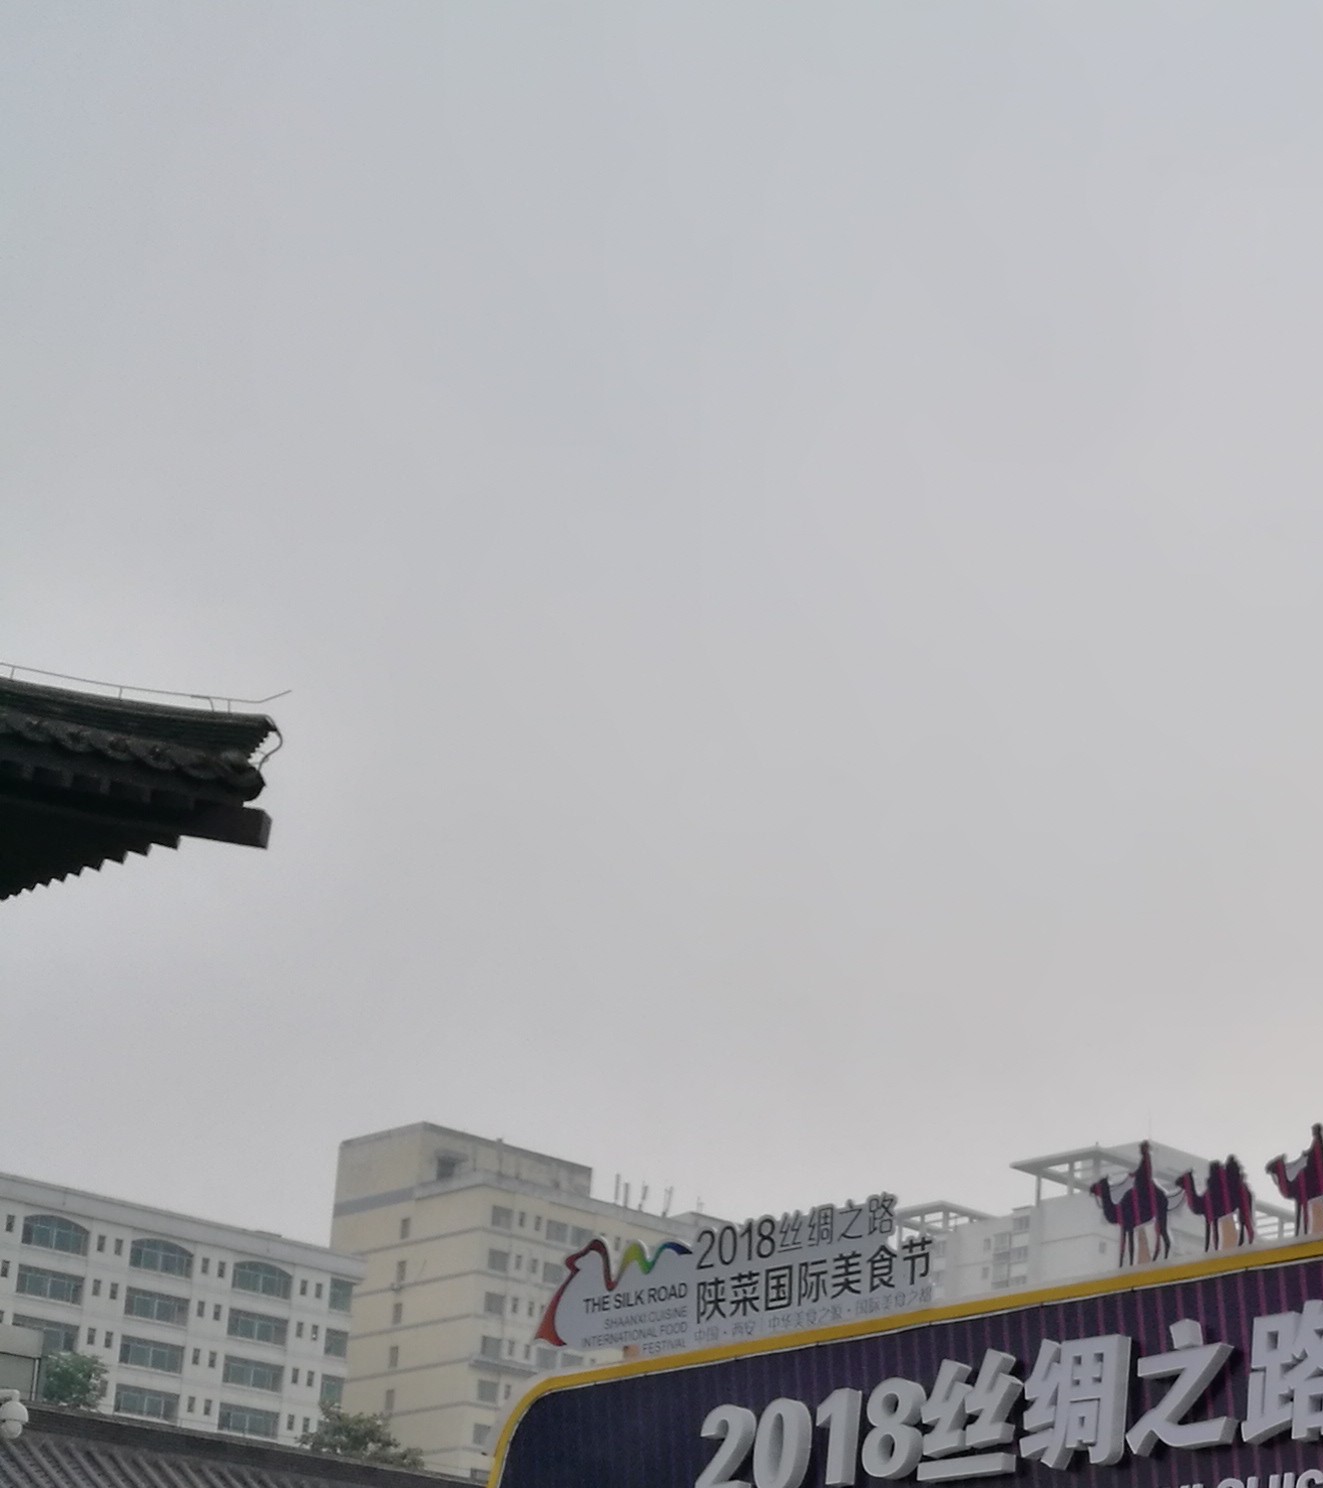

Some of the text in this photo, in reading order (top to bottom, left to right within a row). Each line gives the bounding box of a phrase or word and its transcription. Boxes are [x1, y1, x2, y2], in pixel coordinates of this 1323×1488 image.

[695, 1192, 898, 1270] 2018丝绸之路
[696, 1236, 933, 1324] 陕菜国际美食节
[583, 1282, 688, 1314] THE SILK ROAD
[603, 1305, 688, 1330] SHAANXI CUISINE
[582, 1321, 688, 1348] INTERNATIONAL FOOD
[642, 1337, 687, 1355] FESTIVAL
